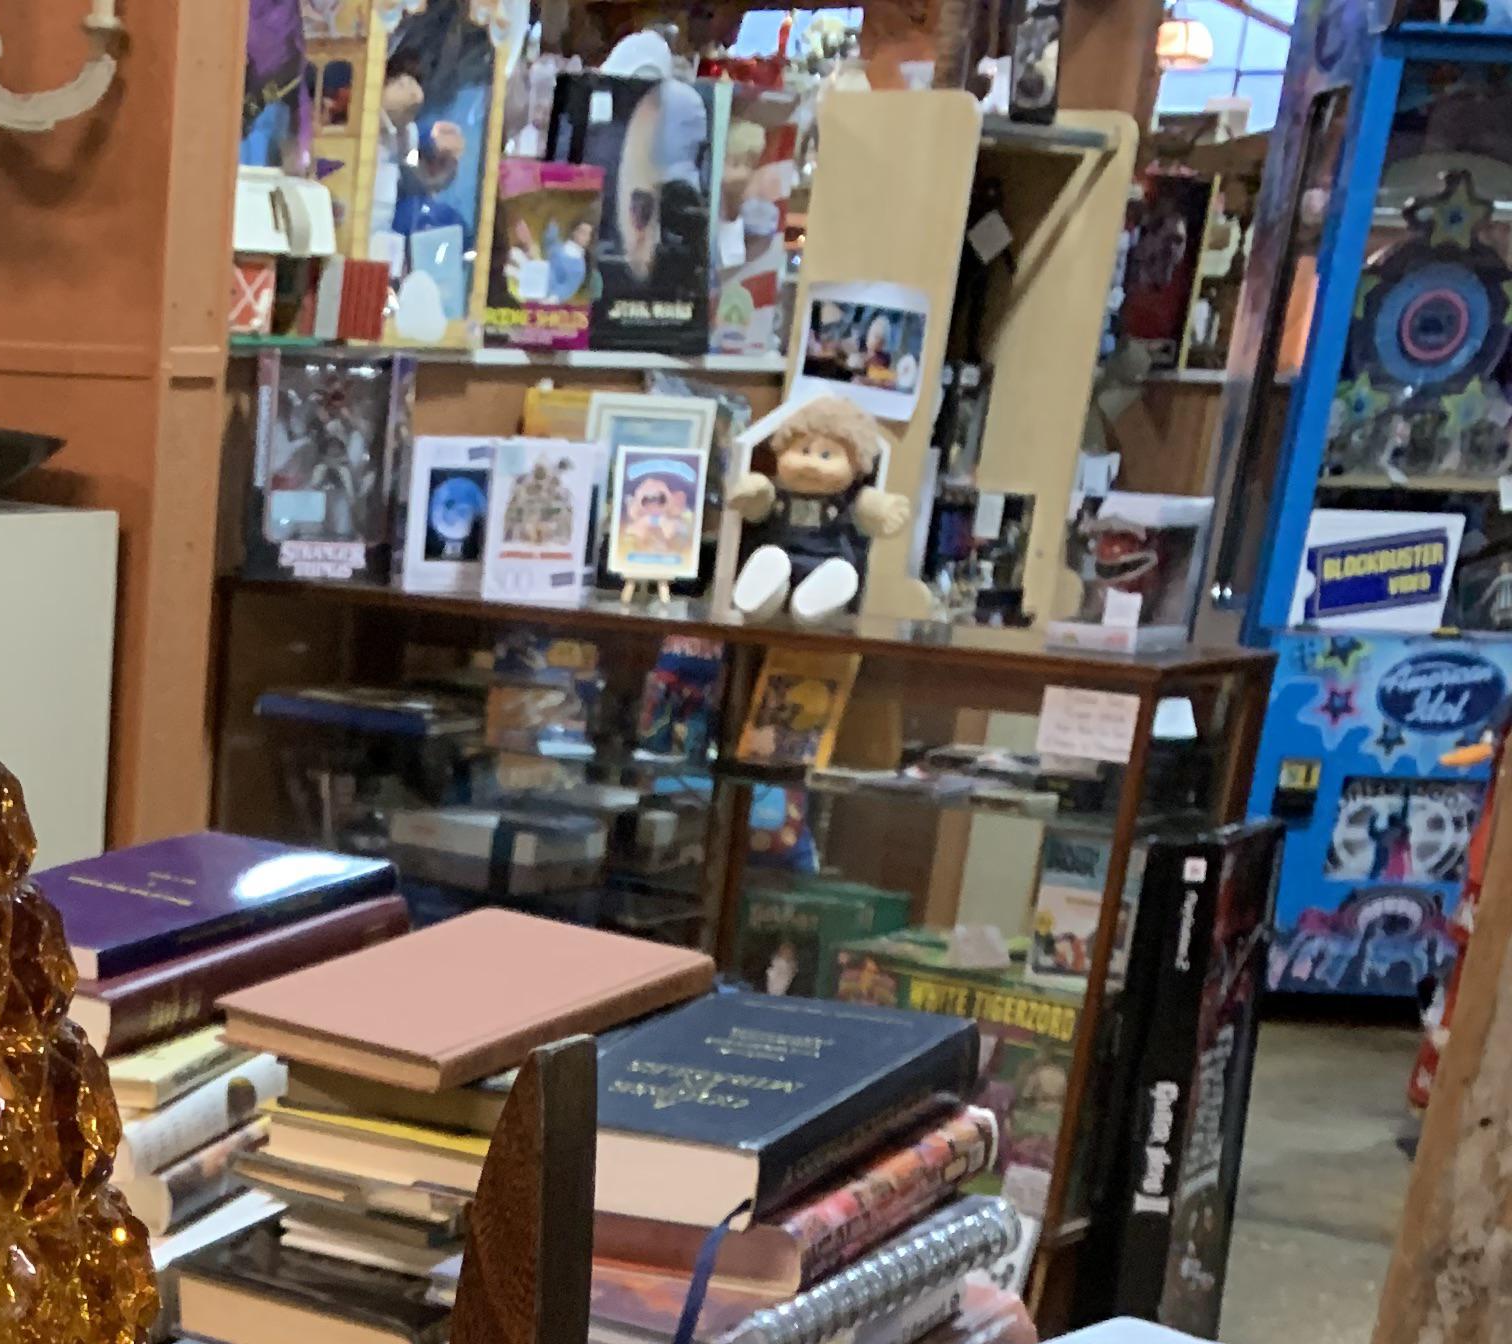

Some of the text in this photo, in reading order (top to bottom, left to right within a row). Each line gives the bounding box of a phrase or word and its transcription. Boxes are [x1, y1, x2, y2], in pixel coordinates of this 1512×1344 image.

[1322, 541, 1444, 581] BLOCKBUSTER
[1381, 658, 1492, 696] American
[1404, 687, 1471, 723] Idol
[909, 976, 969, 1018] WHITE
[972, 988, 1077, 1042] TIGERZORD
